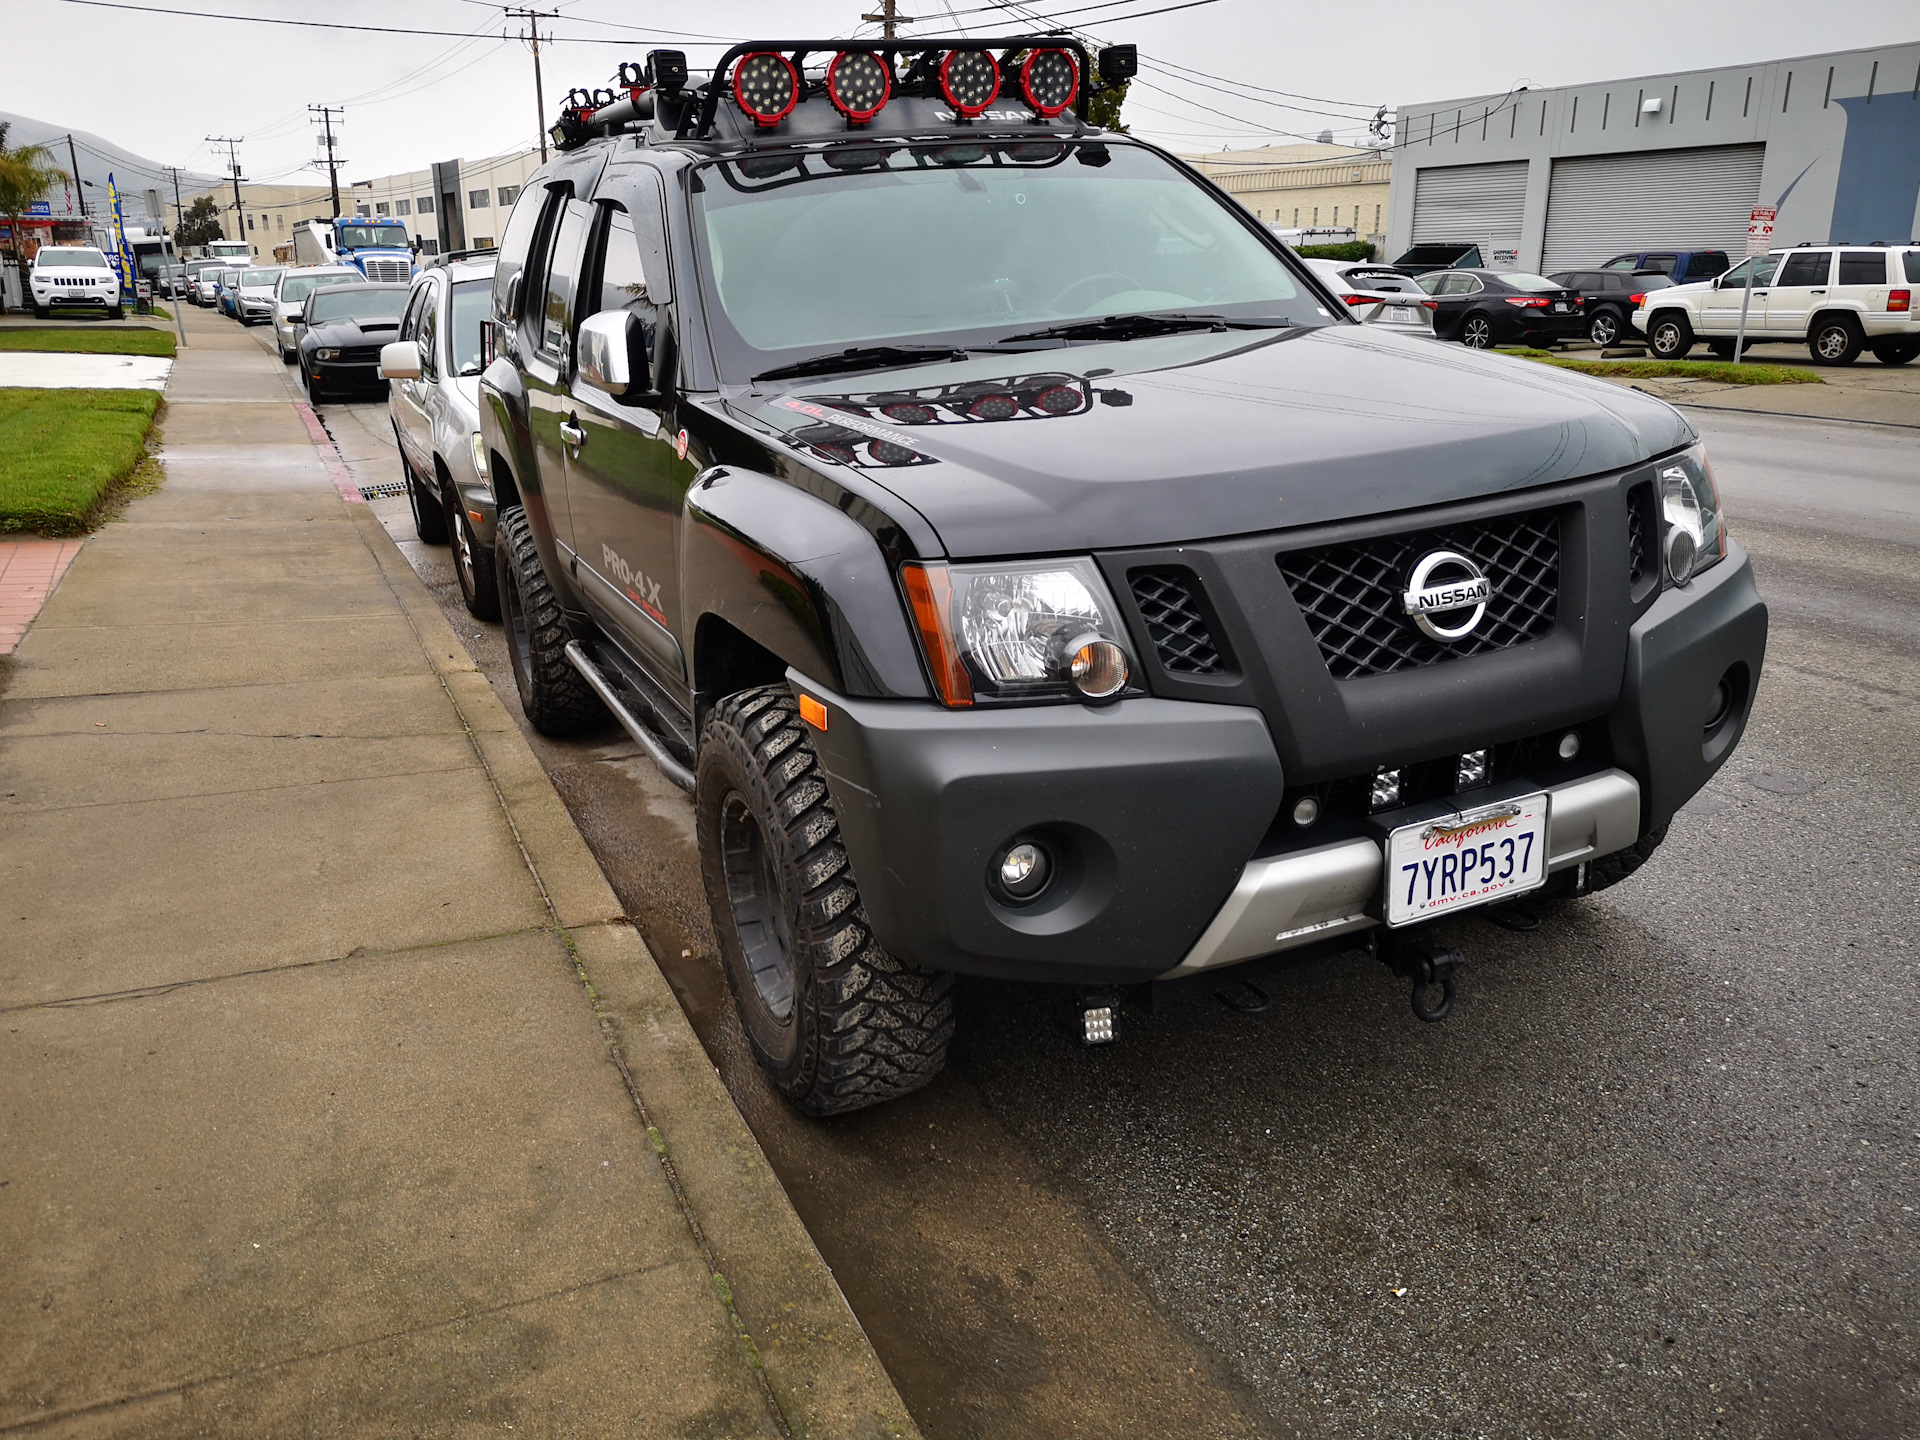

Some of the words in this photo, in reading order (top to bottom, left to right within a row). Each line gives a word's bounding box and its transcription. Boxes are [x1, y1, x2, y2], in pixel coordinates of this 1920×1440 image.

[934, 110, 1043, 121] NSAN
[784, 400, 825, 418] 4.0L
[826, 413, 921, 447] PERFORMANCE
[602, 542, 664, 613] PRO-4X
[626, 586, 642, 604] OFF
[641, 598, 668, 628] ROAD
[1419, 584, 1487, 609] NISSAN
[1402, 831, 1535, 906] 7YRP537
[1428, 881, 1506, 908] dmv.ca.gov
